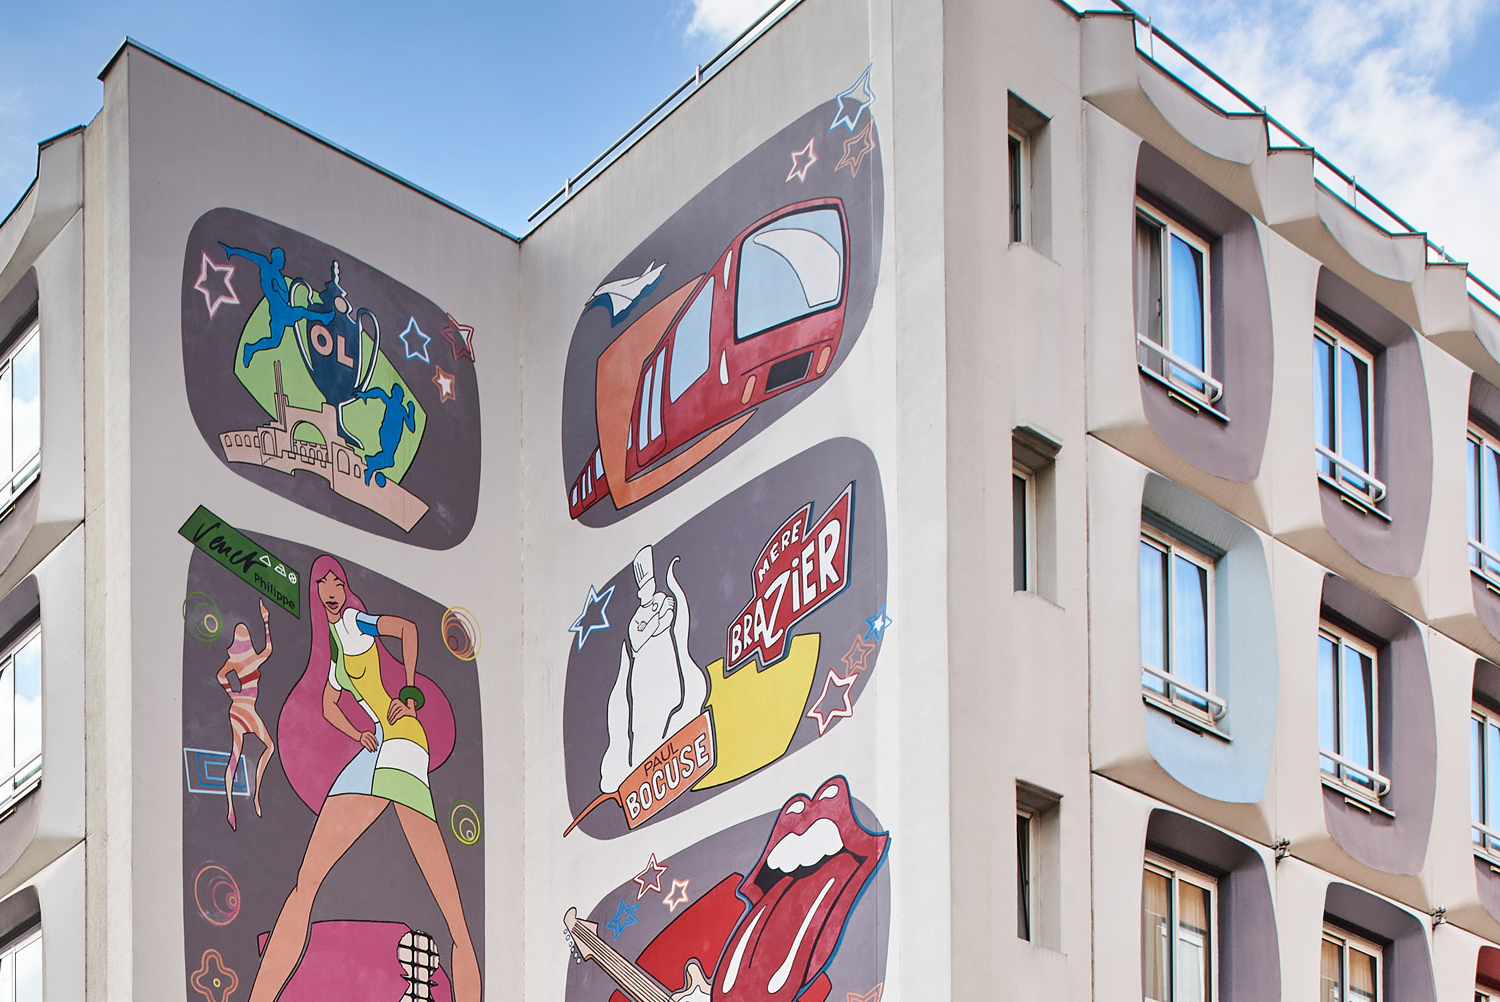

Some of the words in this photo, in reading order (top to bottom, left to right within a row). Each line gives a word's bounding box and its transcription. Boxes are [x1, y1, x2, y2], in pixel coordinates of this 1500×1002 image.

[310, 324, 354, 368] OL
[758, 518, 802, 582] MERE
[254, 573, 295, 610] Philippe
[626, 734, 710, 819] BOCUSE
[644, 742, 679, 777] PAUL
